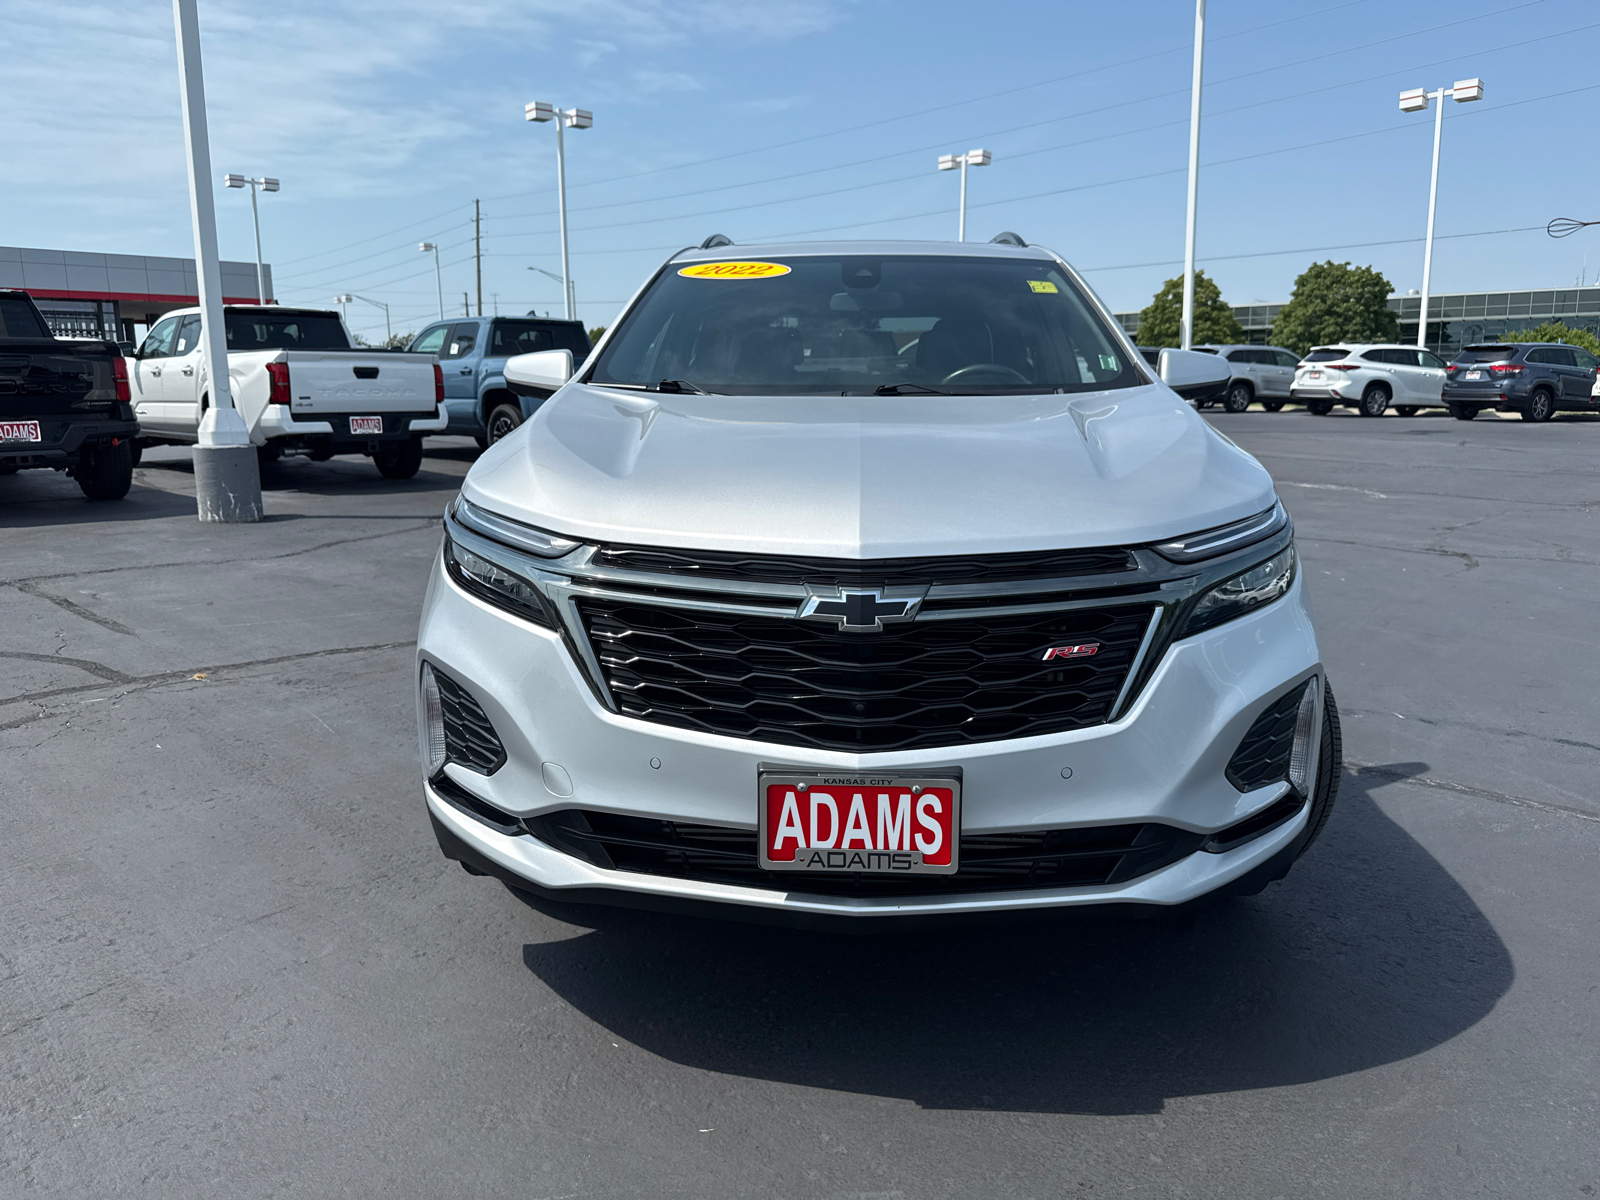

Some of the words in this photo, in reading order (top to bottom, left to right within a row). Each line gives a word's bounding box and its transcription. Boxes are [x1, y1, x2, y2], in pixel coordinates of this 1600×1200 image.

[693, 265, 774, 276] 2022
[317, 388, 417, 397] TACOMA
[353, 419, 380, 431] ADAMS
[1042, 643, 1100, 660] RS
[823, 778, 866, 786] KANSAS
[773, 791, 943, 855] ADAMS
[806, 851, 912, 870] ADAMS
